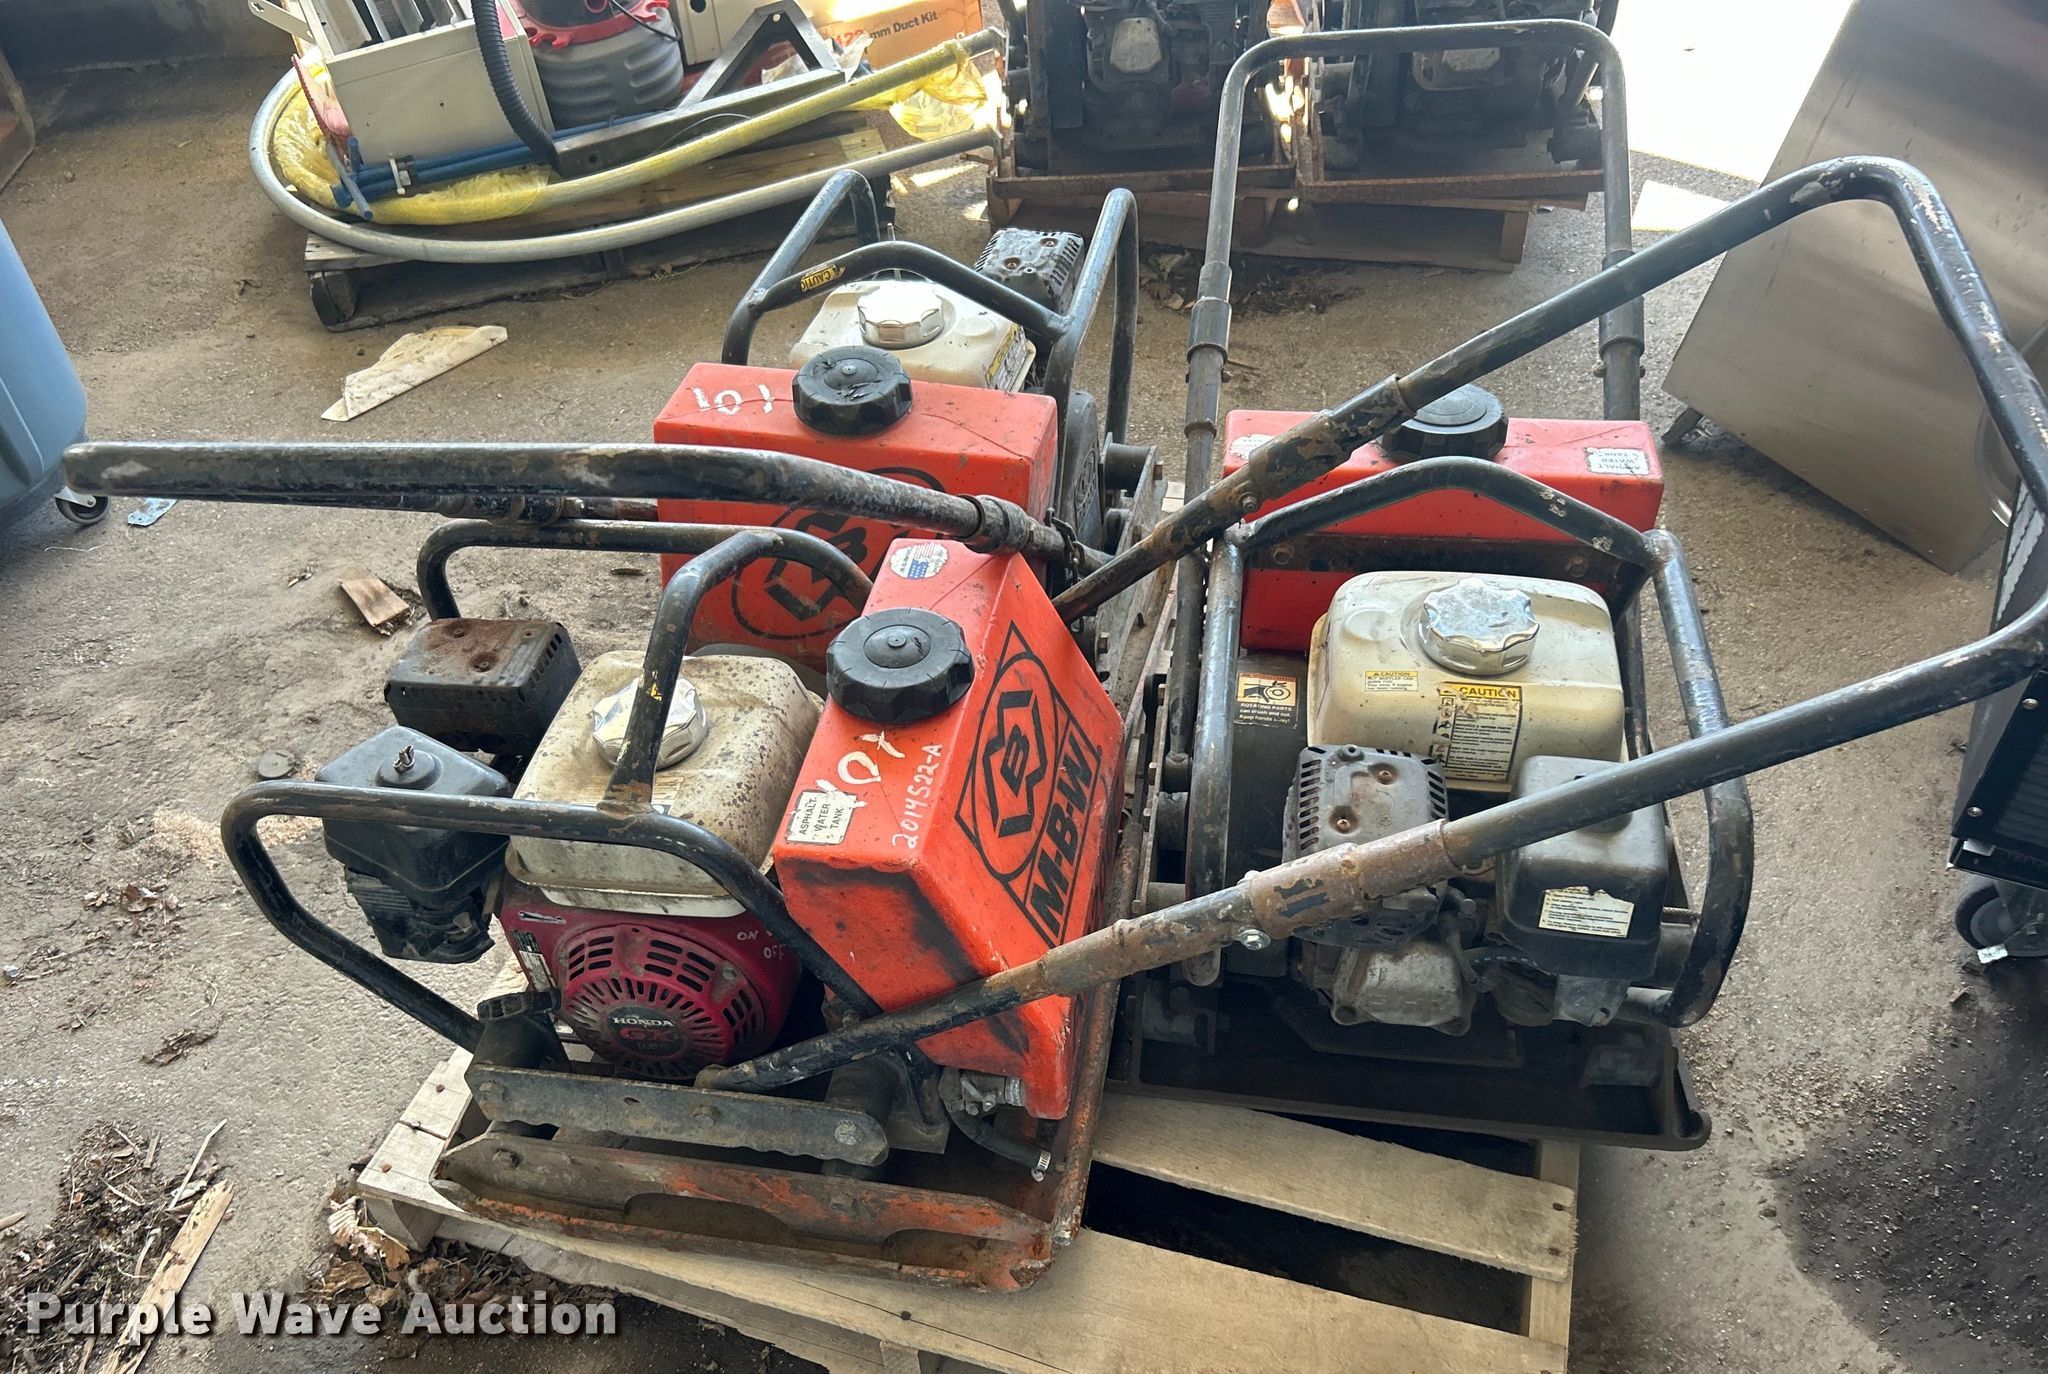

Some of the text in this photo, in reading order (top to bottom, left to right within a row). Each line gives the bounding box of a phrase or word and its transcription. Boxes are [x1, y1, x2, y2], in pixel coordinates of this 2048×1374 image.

[893, 17, 919, 33] Duct
[921, 10, 939, 25] Kit
[1459, 686, 1517, 698] CAUTION
[1240, 702, 1271, 710] ROTATING
[1255, 714, 1273, 722] hands
[814, 802, 831, 832] WATER
[830, 807, 844, 830] TANK
[1028, 730, 1093, 939] M-B-W
[736, 929, 759, 941] ON
[763, 943, 787, 961] OFF
[611, 1016, 675, 1028] HONDA
